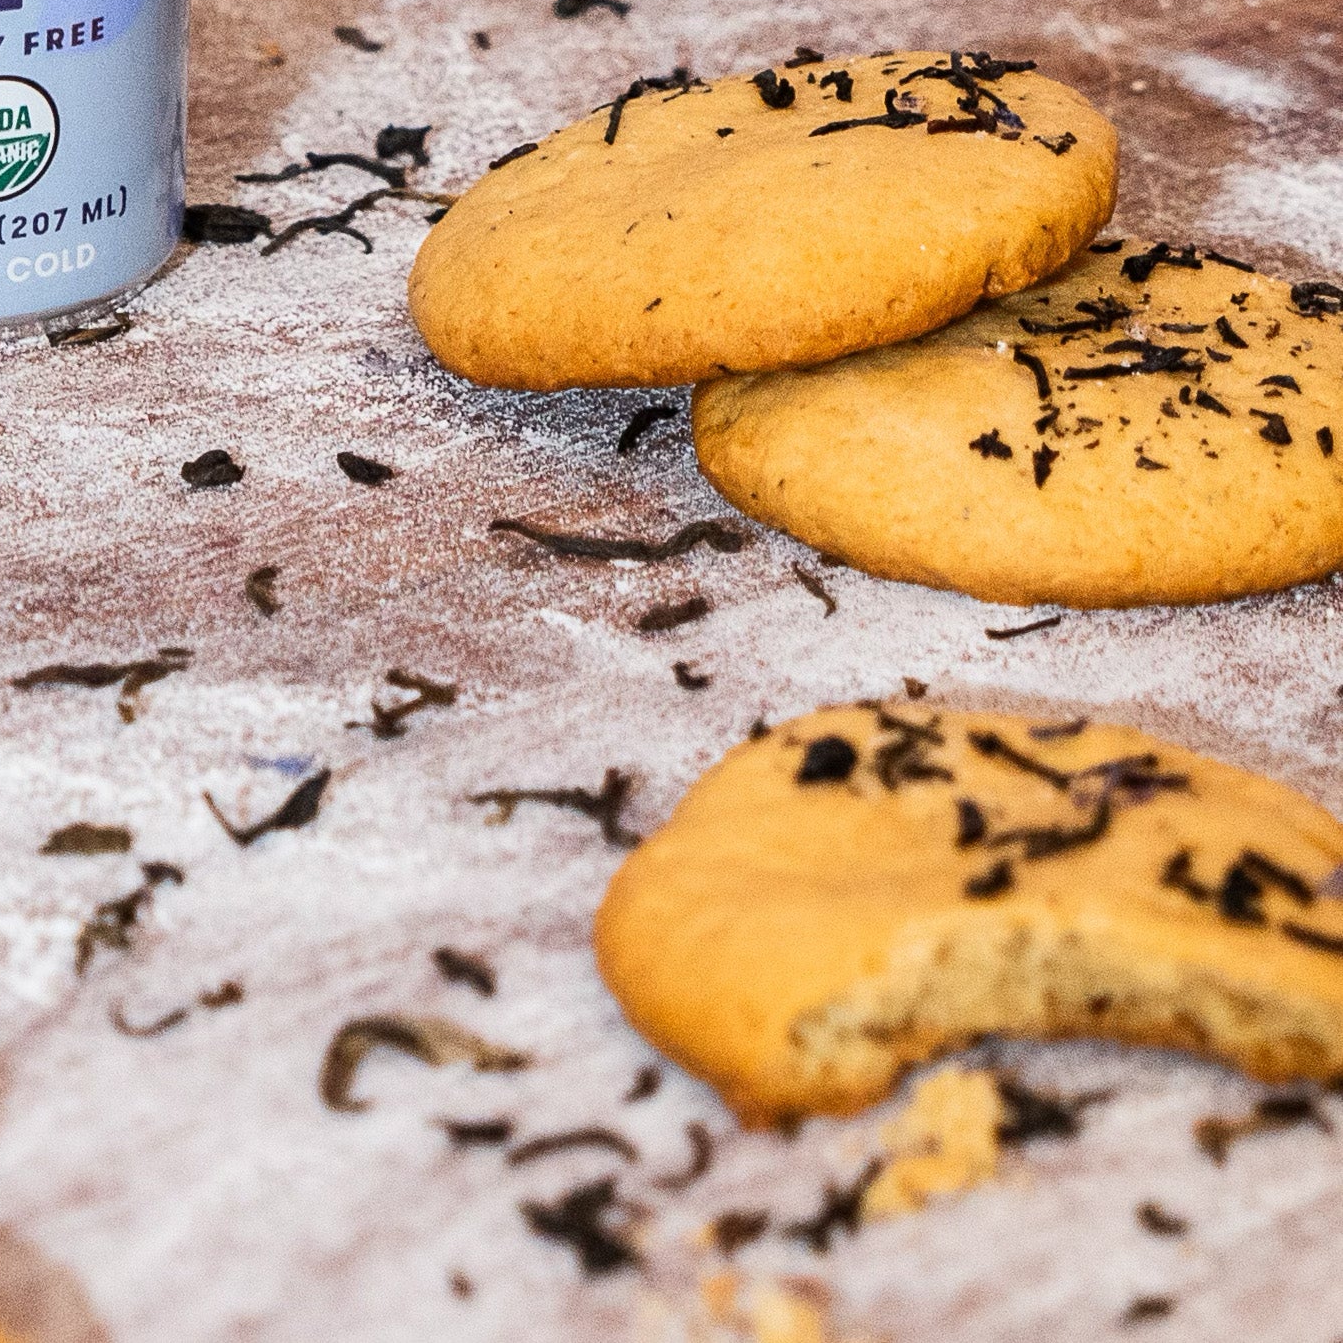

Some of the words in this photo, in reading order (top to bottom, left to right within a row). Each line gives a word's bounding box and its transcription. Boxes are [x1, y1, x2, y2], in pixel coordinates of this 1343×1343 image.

[23, 16, 105, 55] FREE
[81, 185, 128, 225] ML)
[6, 242, 98, 283] COLD
